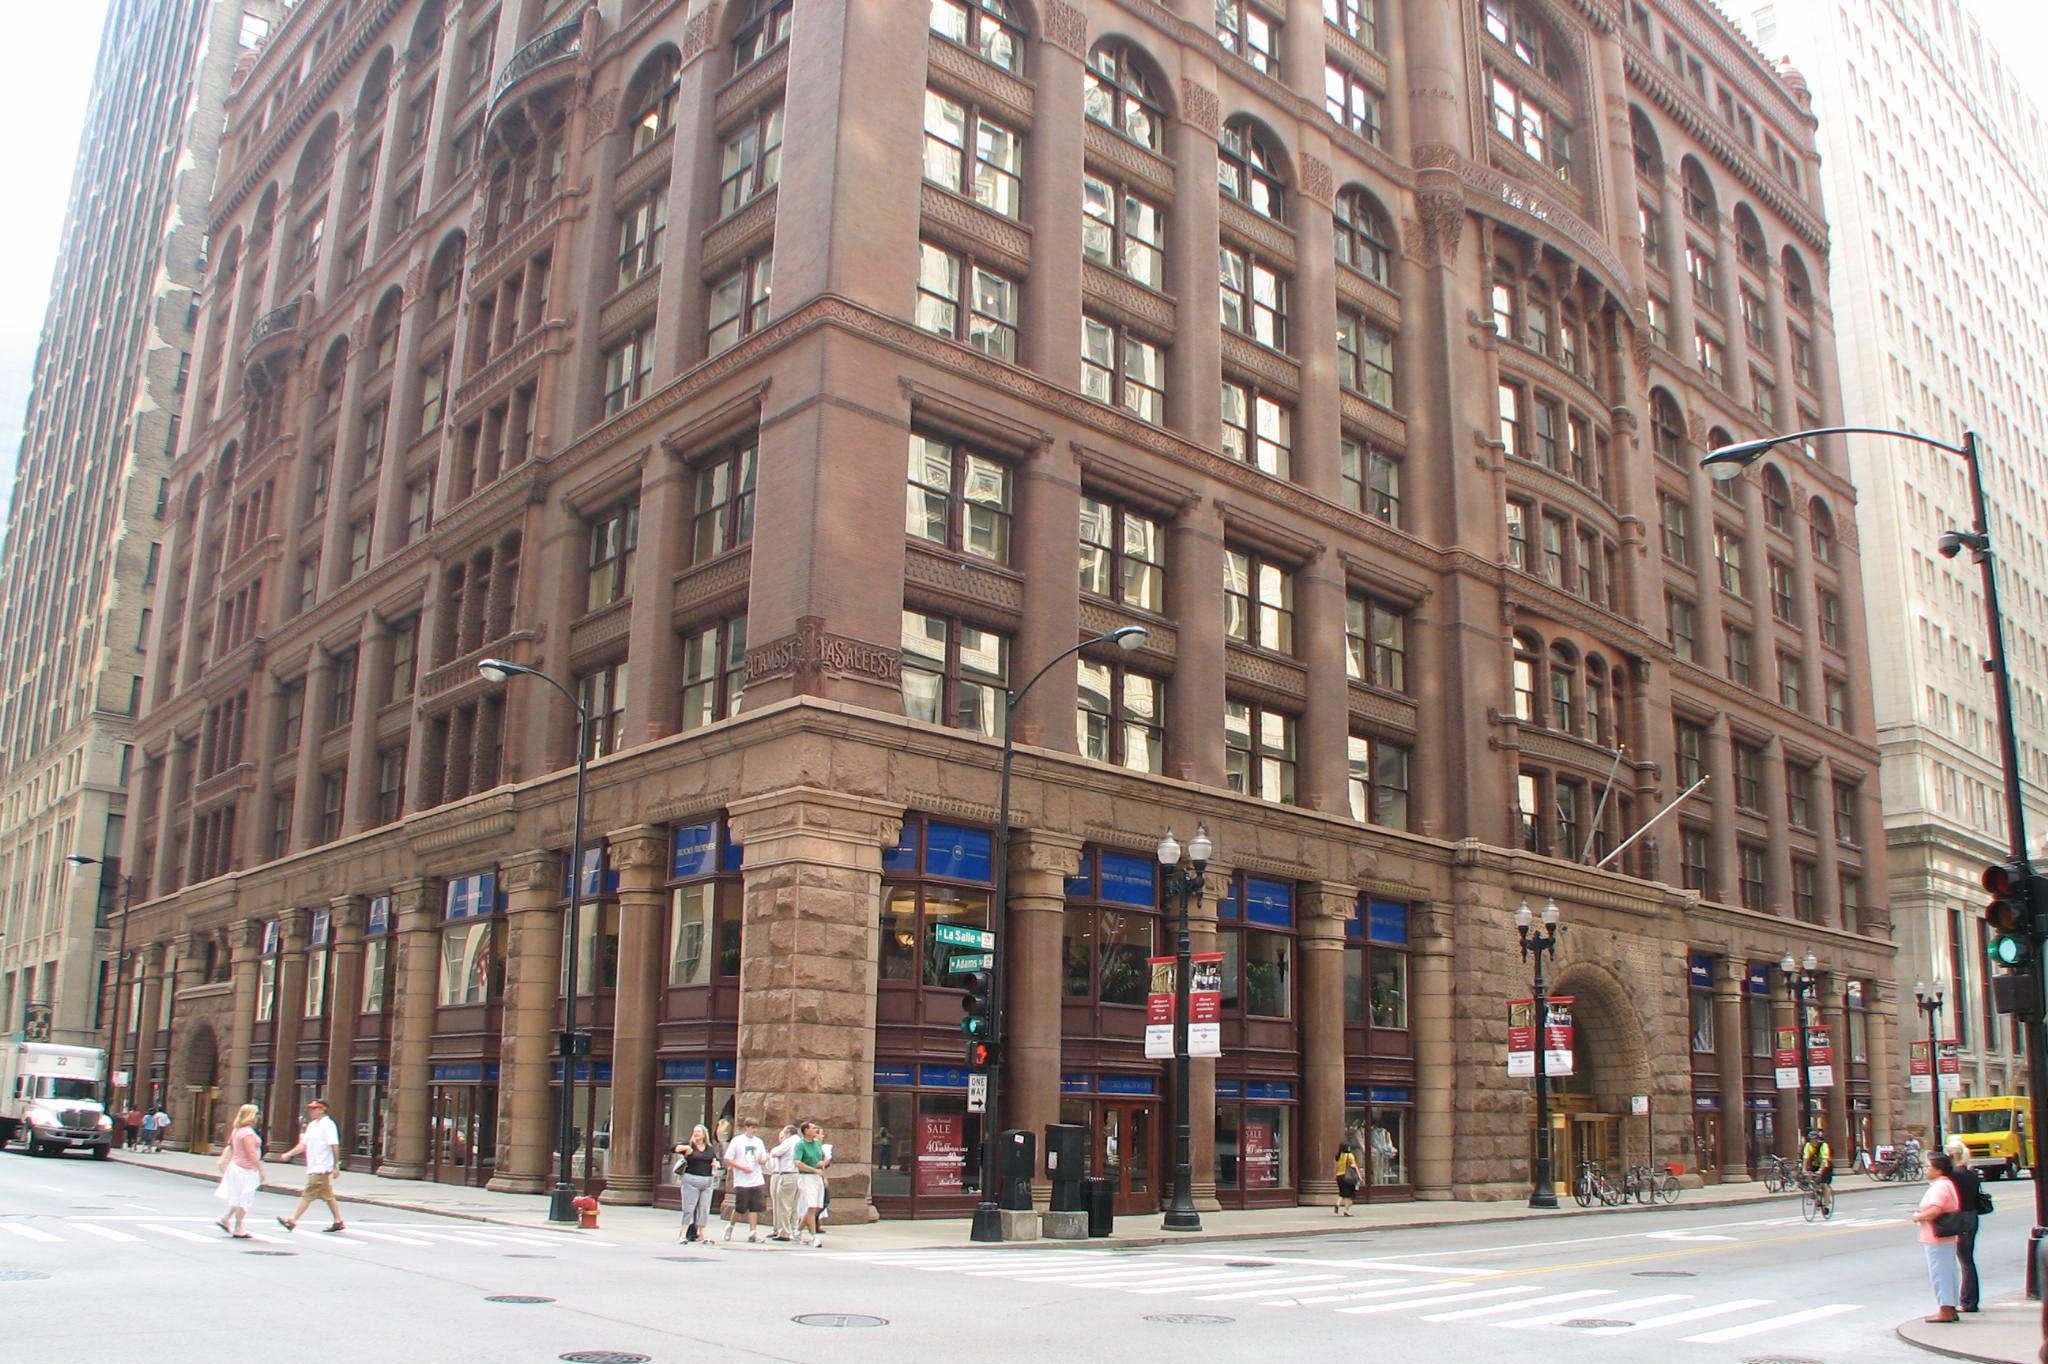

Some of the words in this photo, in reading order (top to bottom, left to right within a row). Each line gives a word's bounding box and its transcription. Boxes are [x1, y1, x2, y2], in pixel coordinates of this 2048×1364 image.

[943, 928, 954, 940] La
[954, 930, 976, 944] Salle
[956, 959, 978, 969] Adams
[927, 1123, 952, 1134] SALE
